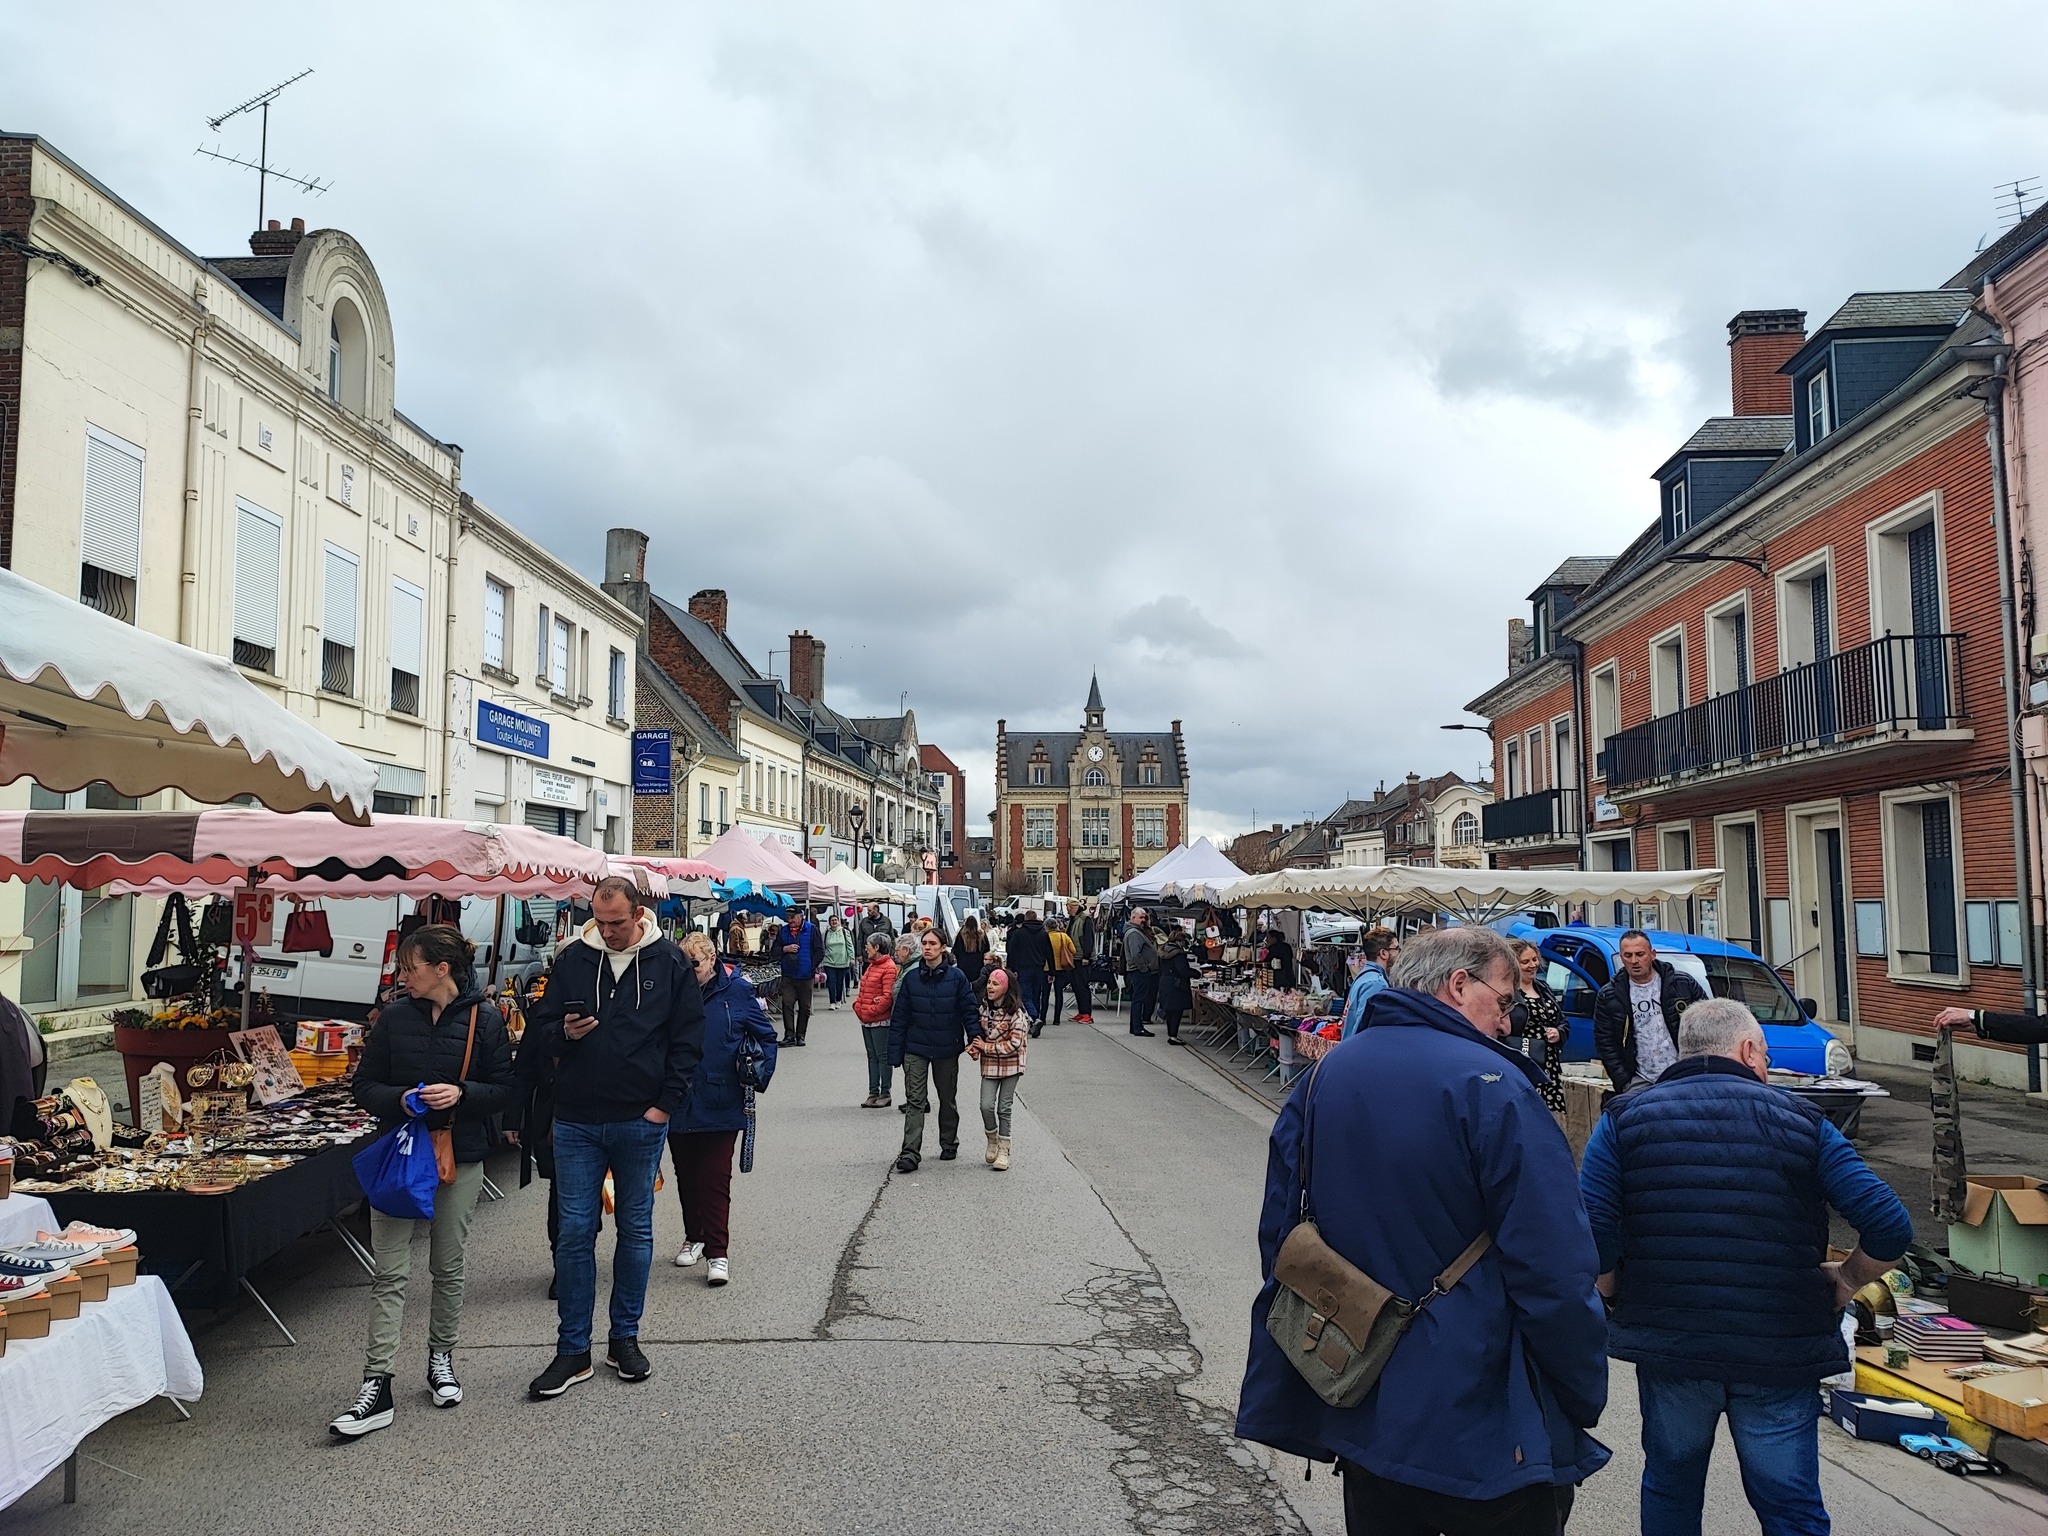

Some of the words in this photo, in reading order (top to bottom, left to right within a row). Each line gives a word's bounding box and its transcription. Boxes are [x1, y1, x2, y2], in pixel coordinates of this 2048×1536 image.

[489, 709, 514, 729] GARAGE
[515, 717, 541, 738] MOUNIER
[496, 727, 513, 744] Toutes
[513, 732, 535, 750] Marques
[636, 732, 669, 740] GARAGE
